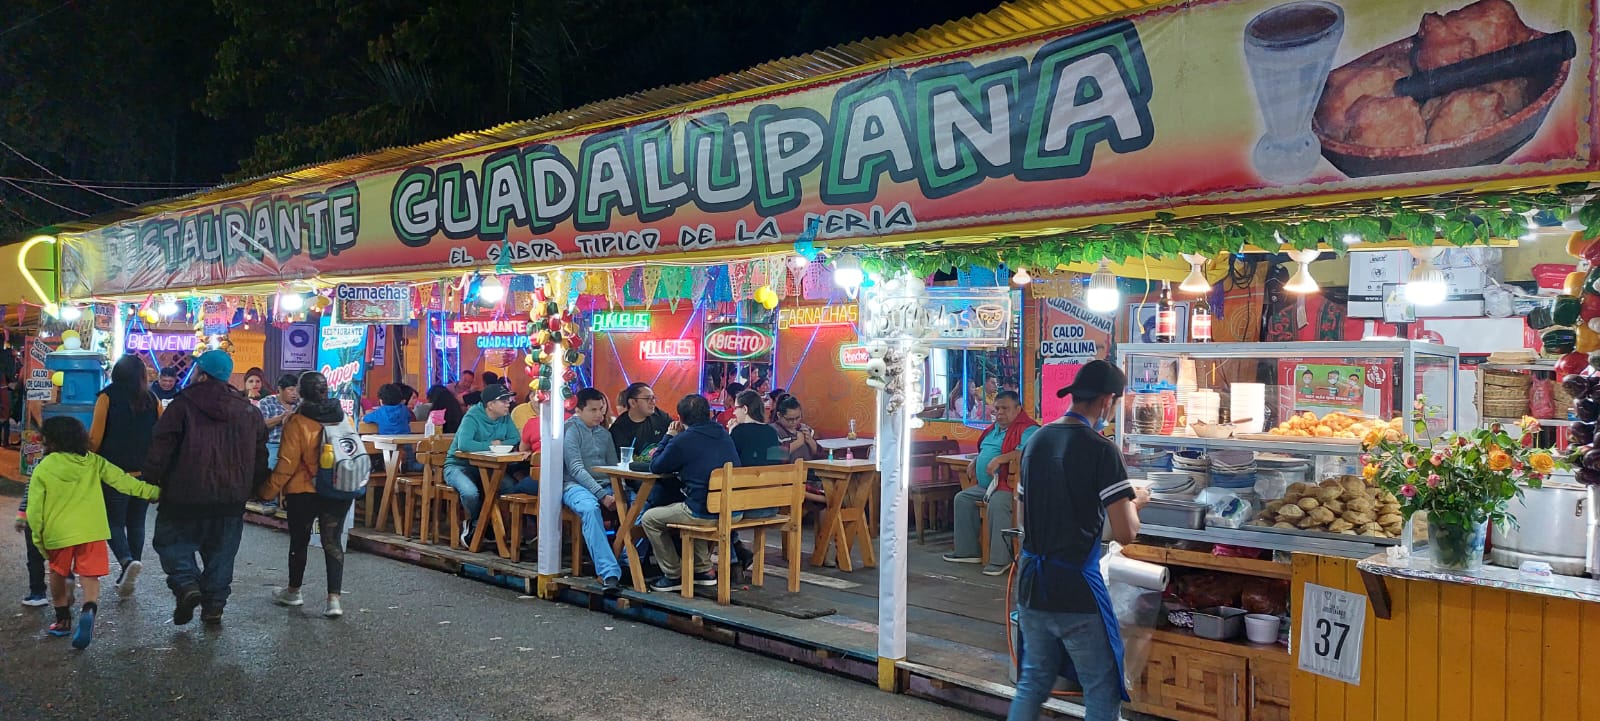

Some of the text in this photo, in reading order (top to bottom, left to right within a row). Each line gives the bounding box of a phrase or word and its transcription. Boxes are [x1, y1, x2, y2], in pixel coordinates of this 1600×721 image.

[102, 20, 1153, 281] RESTAURANTE GUADALUPANA
[451, 250, 472, 264] EL
[577, 232, 658, 255] TIPICO
[681, 228, 713, 248] DE
[737, 221, 779, 242] LA
[337, 283, 409, 299] Garnachas
[778, 304, 859, 330] GARNACHAS
[1047, 296, 1112, 331] GUADALUPANA
[453, 321, 526, 333] RESTAURANTE
[1053, 326, 1084, 337] CALDO
[127, 333, 197, 350] BIENVENID
[476, 336, 532, 348] GUADALUPA
[708, 334, 761, 351] ABIERTO
[1042, 342, 1096, 354] DE GALLINA
[1314, 618, 1350, 660] 37
